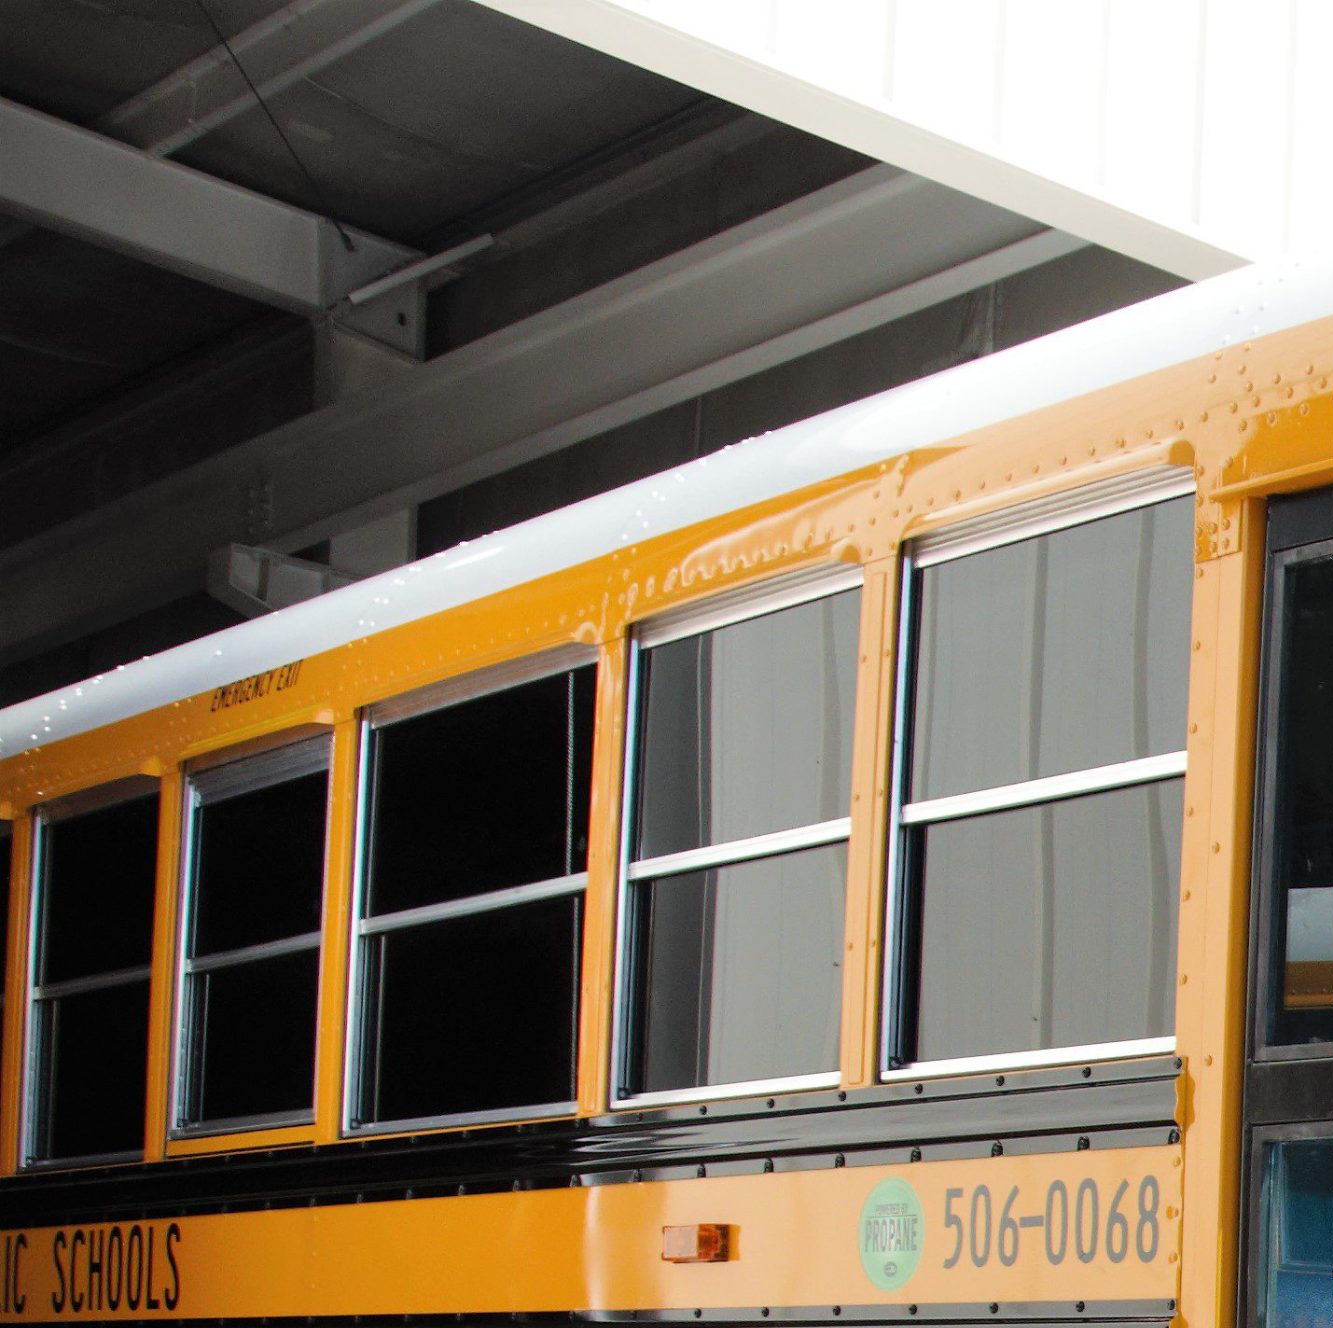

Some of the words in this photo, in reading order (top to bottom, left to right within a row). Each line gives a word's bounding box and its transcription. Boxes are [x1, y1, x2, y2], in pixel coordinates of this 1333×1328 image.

[52, 1222, 181, 1313] SCHOOLS
[865, 1217, 918, 1252] PROPANE
[943, 1175, 1160, 1269] 506-0068
